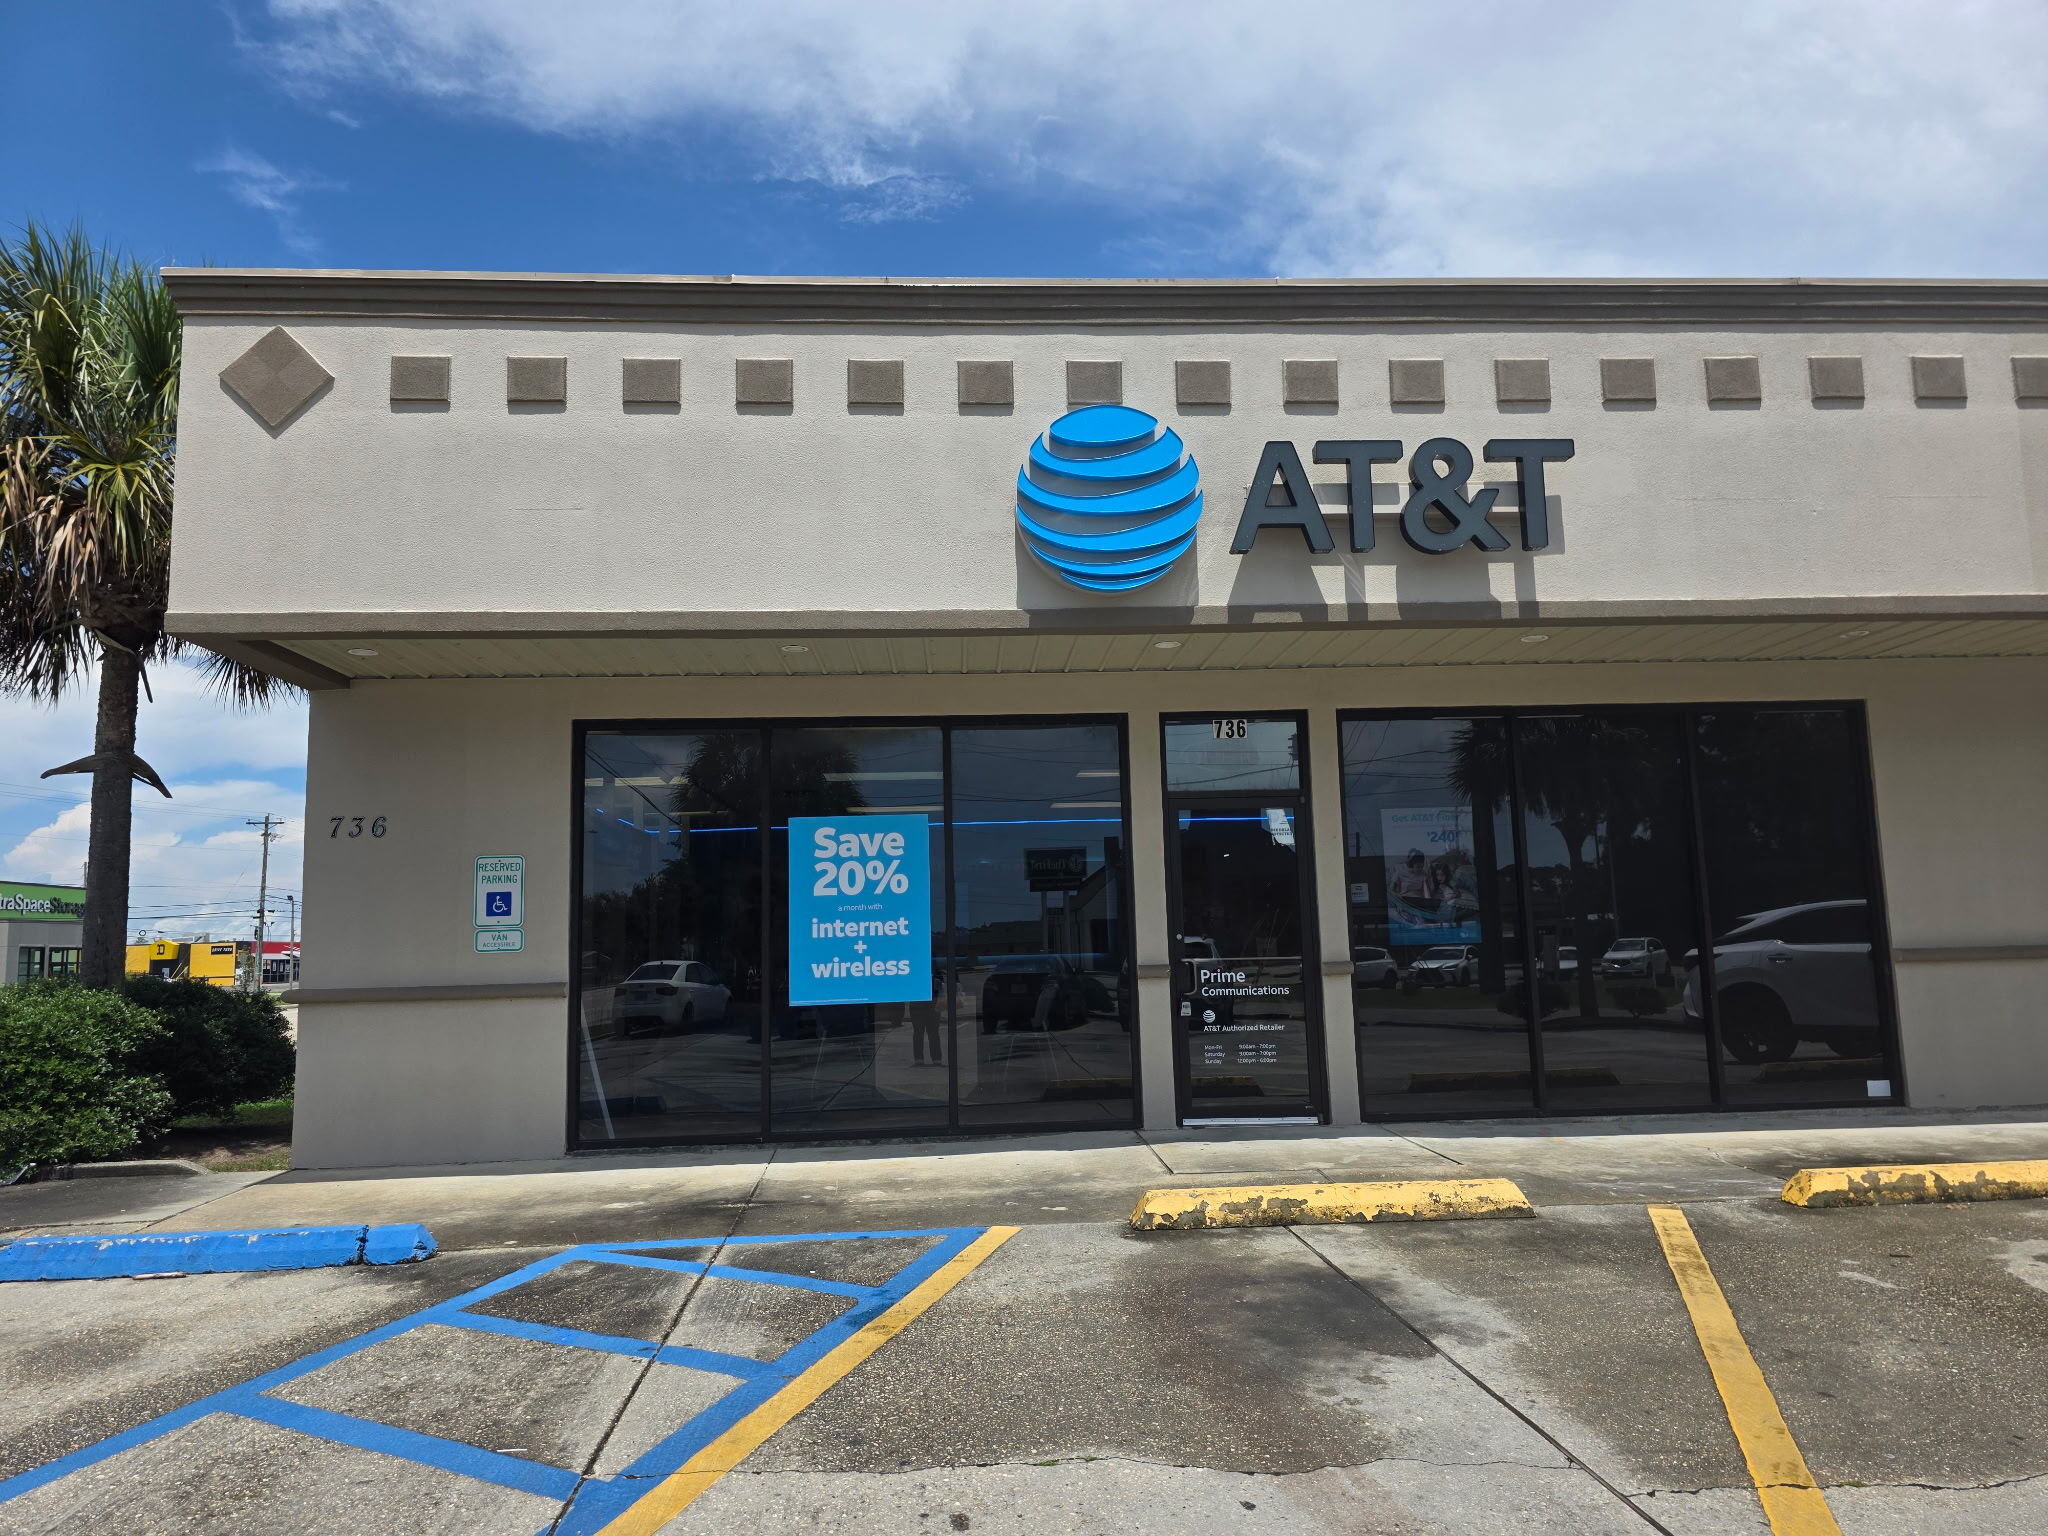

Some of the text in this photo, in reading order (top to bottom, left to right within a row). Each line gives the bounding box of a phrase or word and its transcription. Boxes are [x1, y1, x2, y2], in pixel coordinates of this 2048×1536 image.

[1229, 437, 1575, 554] AT&T
[1213, 720, 1246, 738] 736
[330, 816, 387, 838] 736
[814, 827, 904, 858] Save
[479, 862, 520, 872] RESERVED
[482, 875, 517, 884] PARKING
[813, 860, 909, 896] 20%
[812, 917, 909, 938] internet
[854, 940, 867, 953] +
[811, 955, 910, 978] wireless
[1200, 968, 1245, 983] Prime
[1201, 985, 1290, 996] Communications
[1260, 1023, 1285, 1031] Retailer
